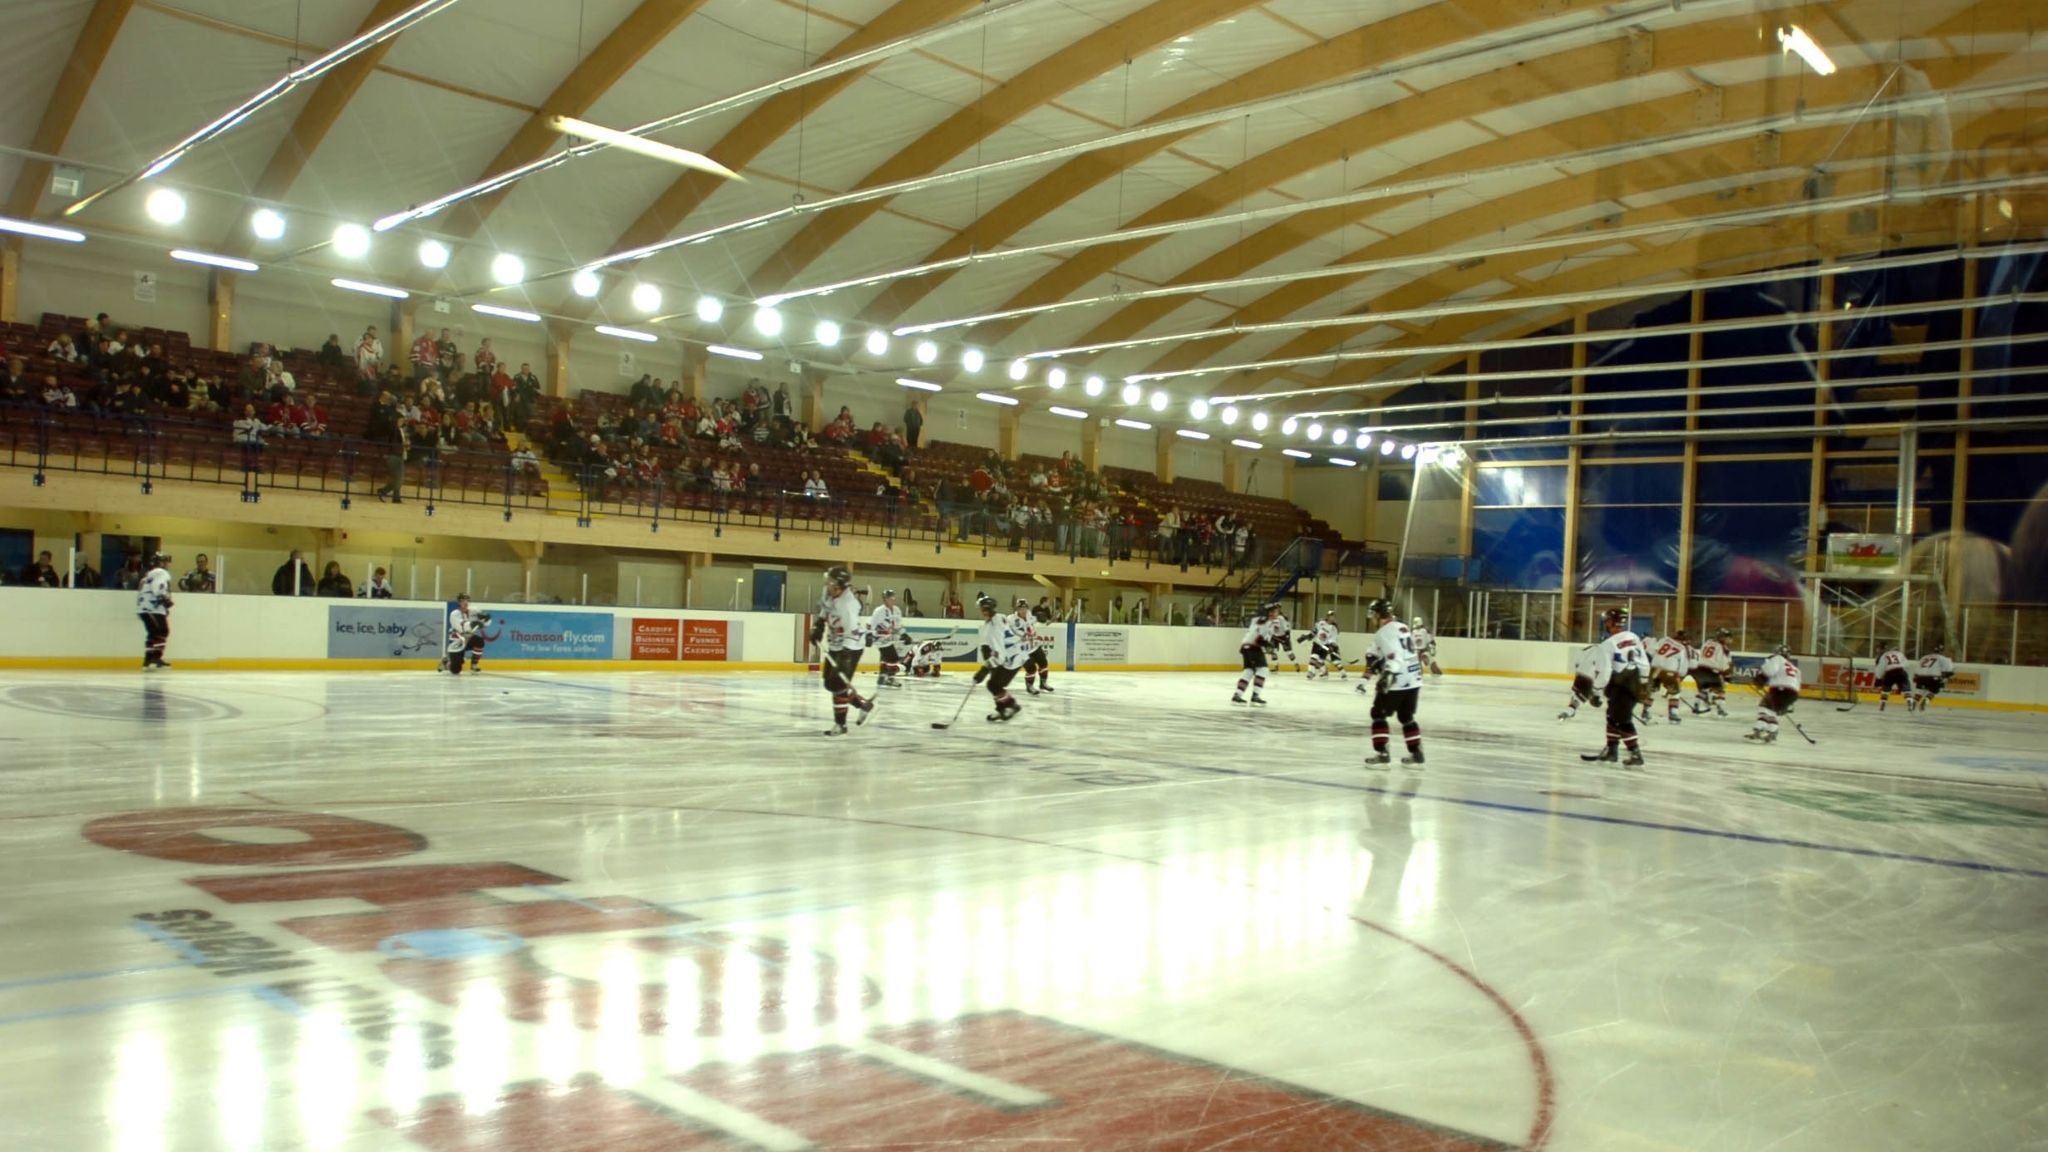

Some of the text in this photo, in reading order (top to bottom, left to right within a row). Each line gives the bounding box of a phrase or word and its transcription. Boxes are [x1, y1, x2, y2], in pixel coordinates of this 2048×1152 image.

[378, 622, 408, 638] baby
[638, 625, 673, 633] CARDIFF
[511, 630, 605, 645] Thomsonfly.com
[635, 635, 675, 643] BUSINESS
[639, 646, 672, 654] SCHOOL
[1658, 643, 1680, 658] 87
[1886, 654, 1900, 666] 13
[1920, 657, 1937, 669] 27
[1823, 663, 1877, 688] ECH
